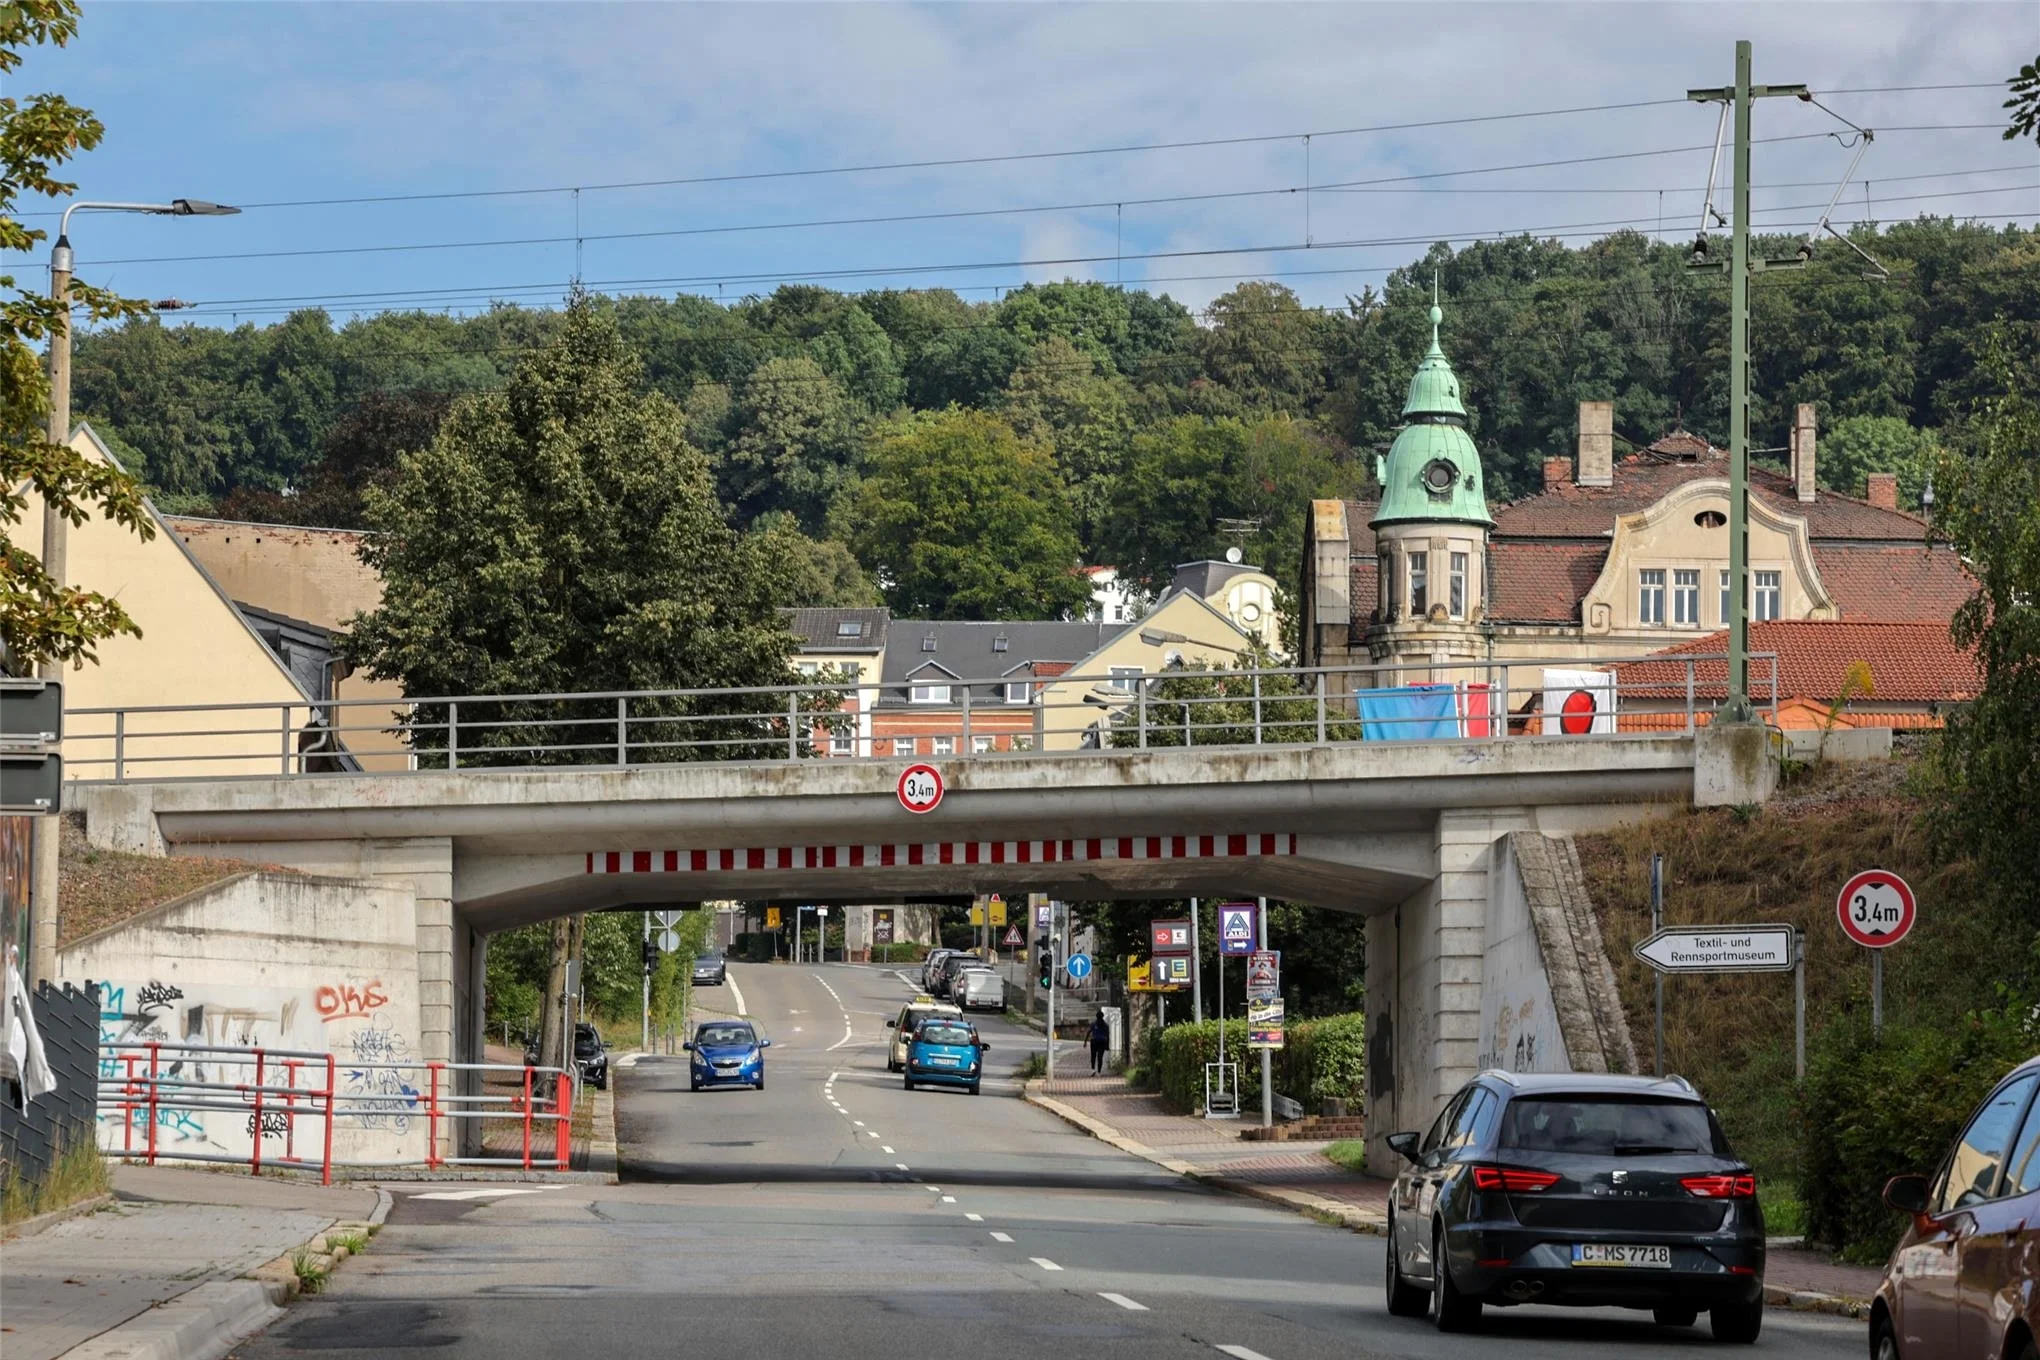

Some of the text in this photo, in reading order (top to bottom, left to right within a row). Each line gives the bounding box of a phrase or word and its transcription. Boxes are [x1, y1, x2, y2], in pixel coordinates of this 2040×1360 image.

[1854, 895, 1899, 923] 3,4m
[1694, 937, 1751, 949] Textil- und
[1671, 951, 1776, 963] Rennsportmuseum
[1594, 1188, 1648, 1197] LEON
